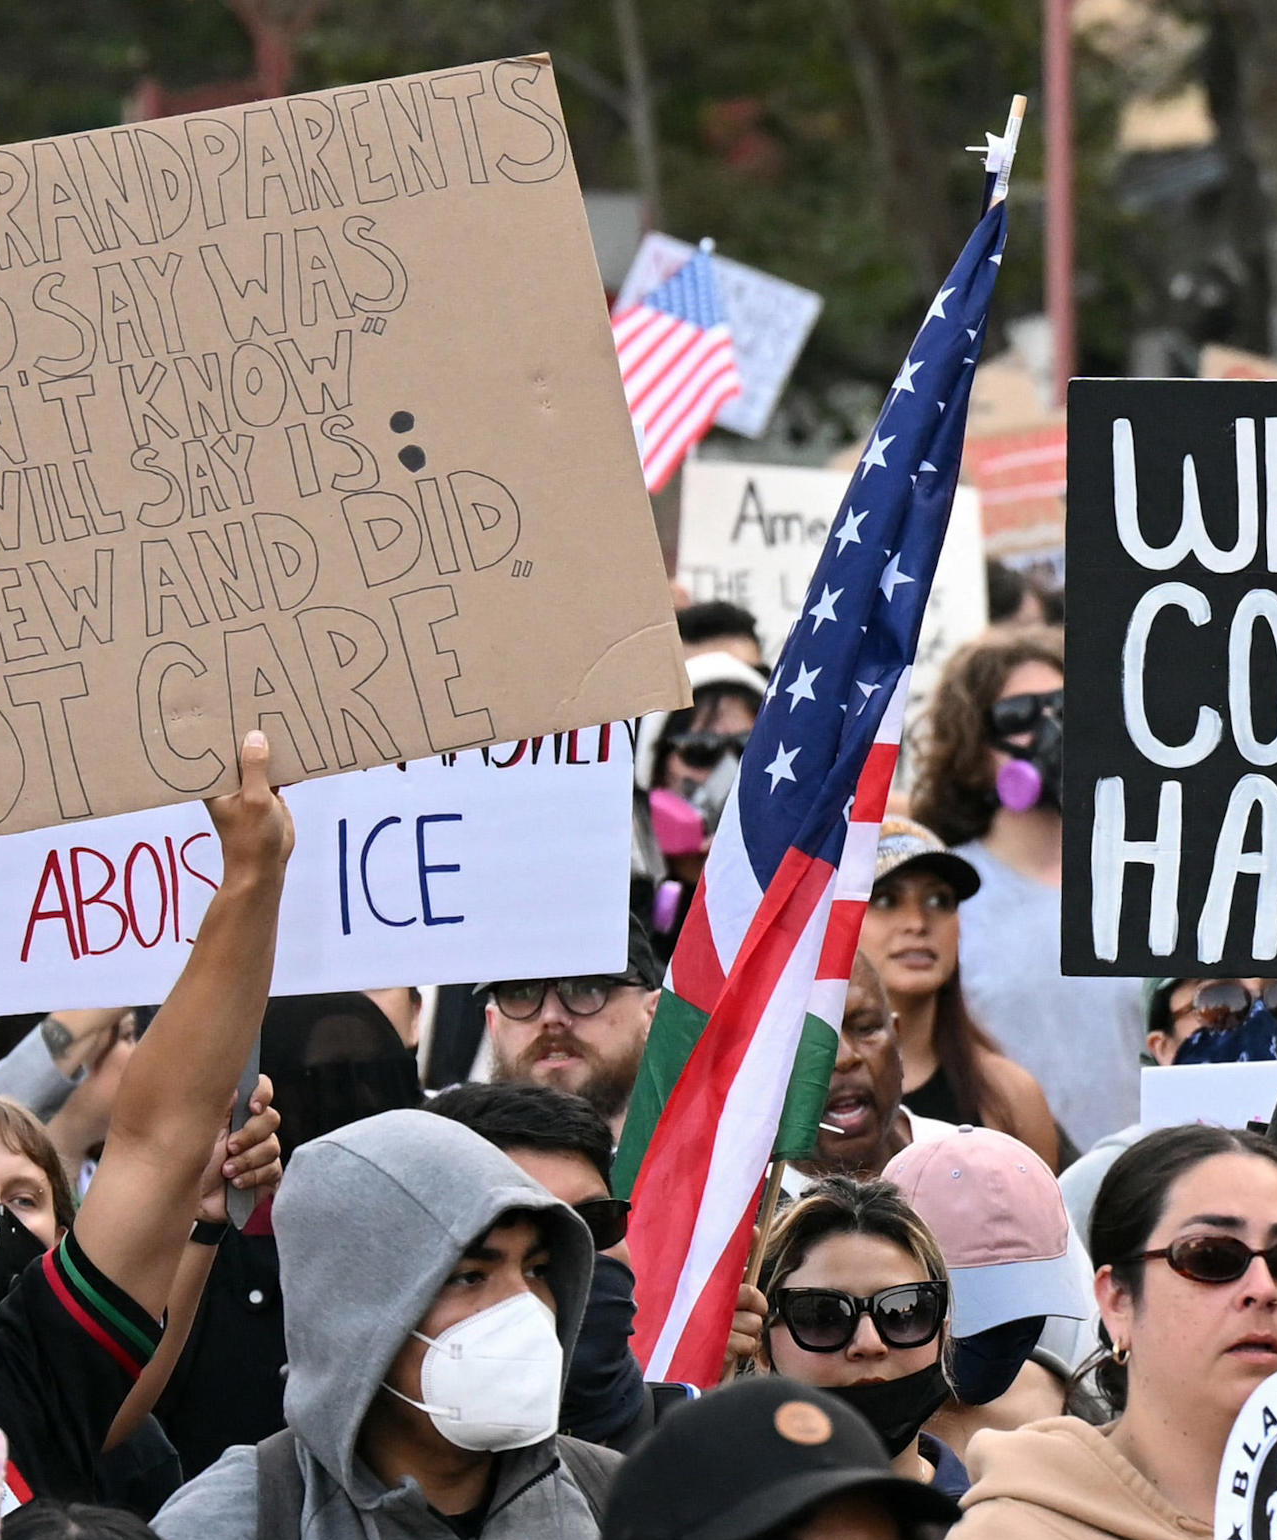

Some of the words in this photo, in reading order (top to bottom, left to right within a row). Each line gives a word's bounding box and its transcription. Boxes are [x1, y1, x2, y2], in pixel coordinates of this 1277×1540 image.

[32, 253, 186, 377] SAY
[198, 216, 408, 343] WAS
[131, 434, 255, 528] SAY
[140, 512, 320, 637] AND
[135, 584, 497, 793] CARE
[338, 814, 465, 936] ICE
